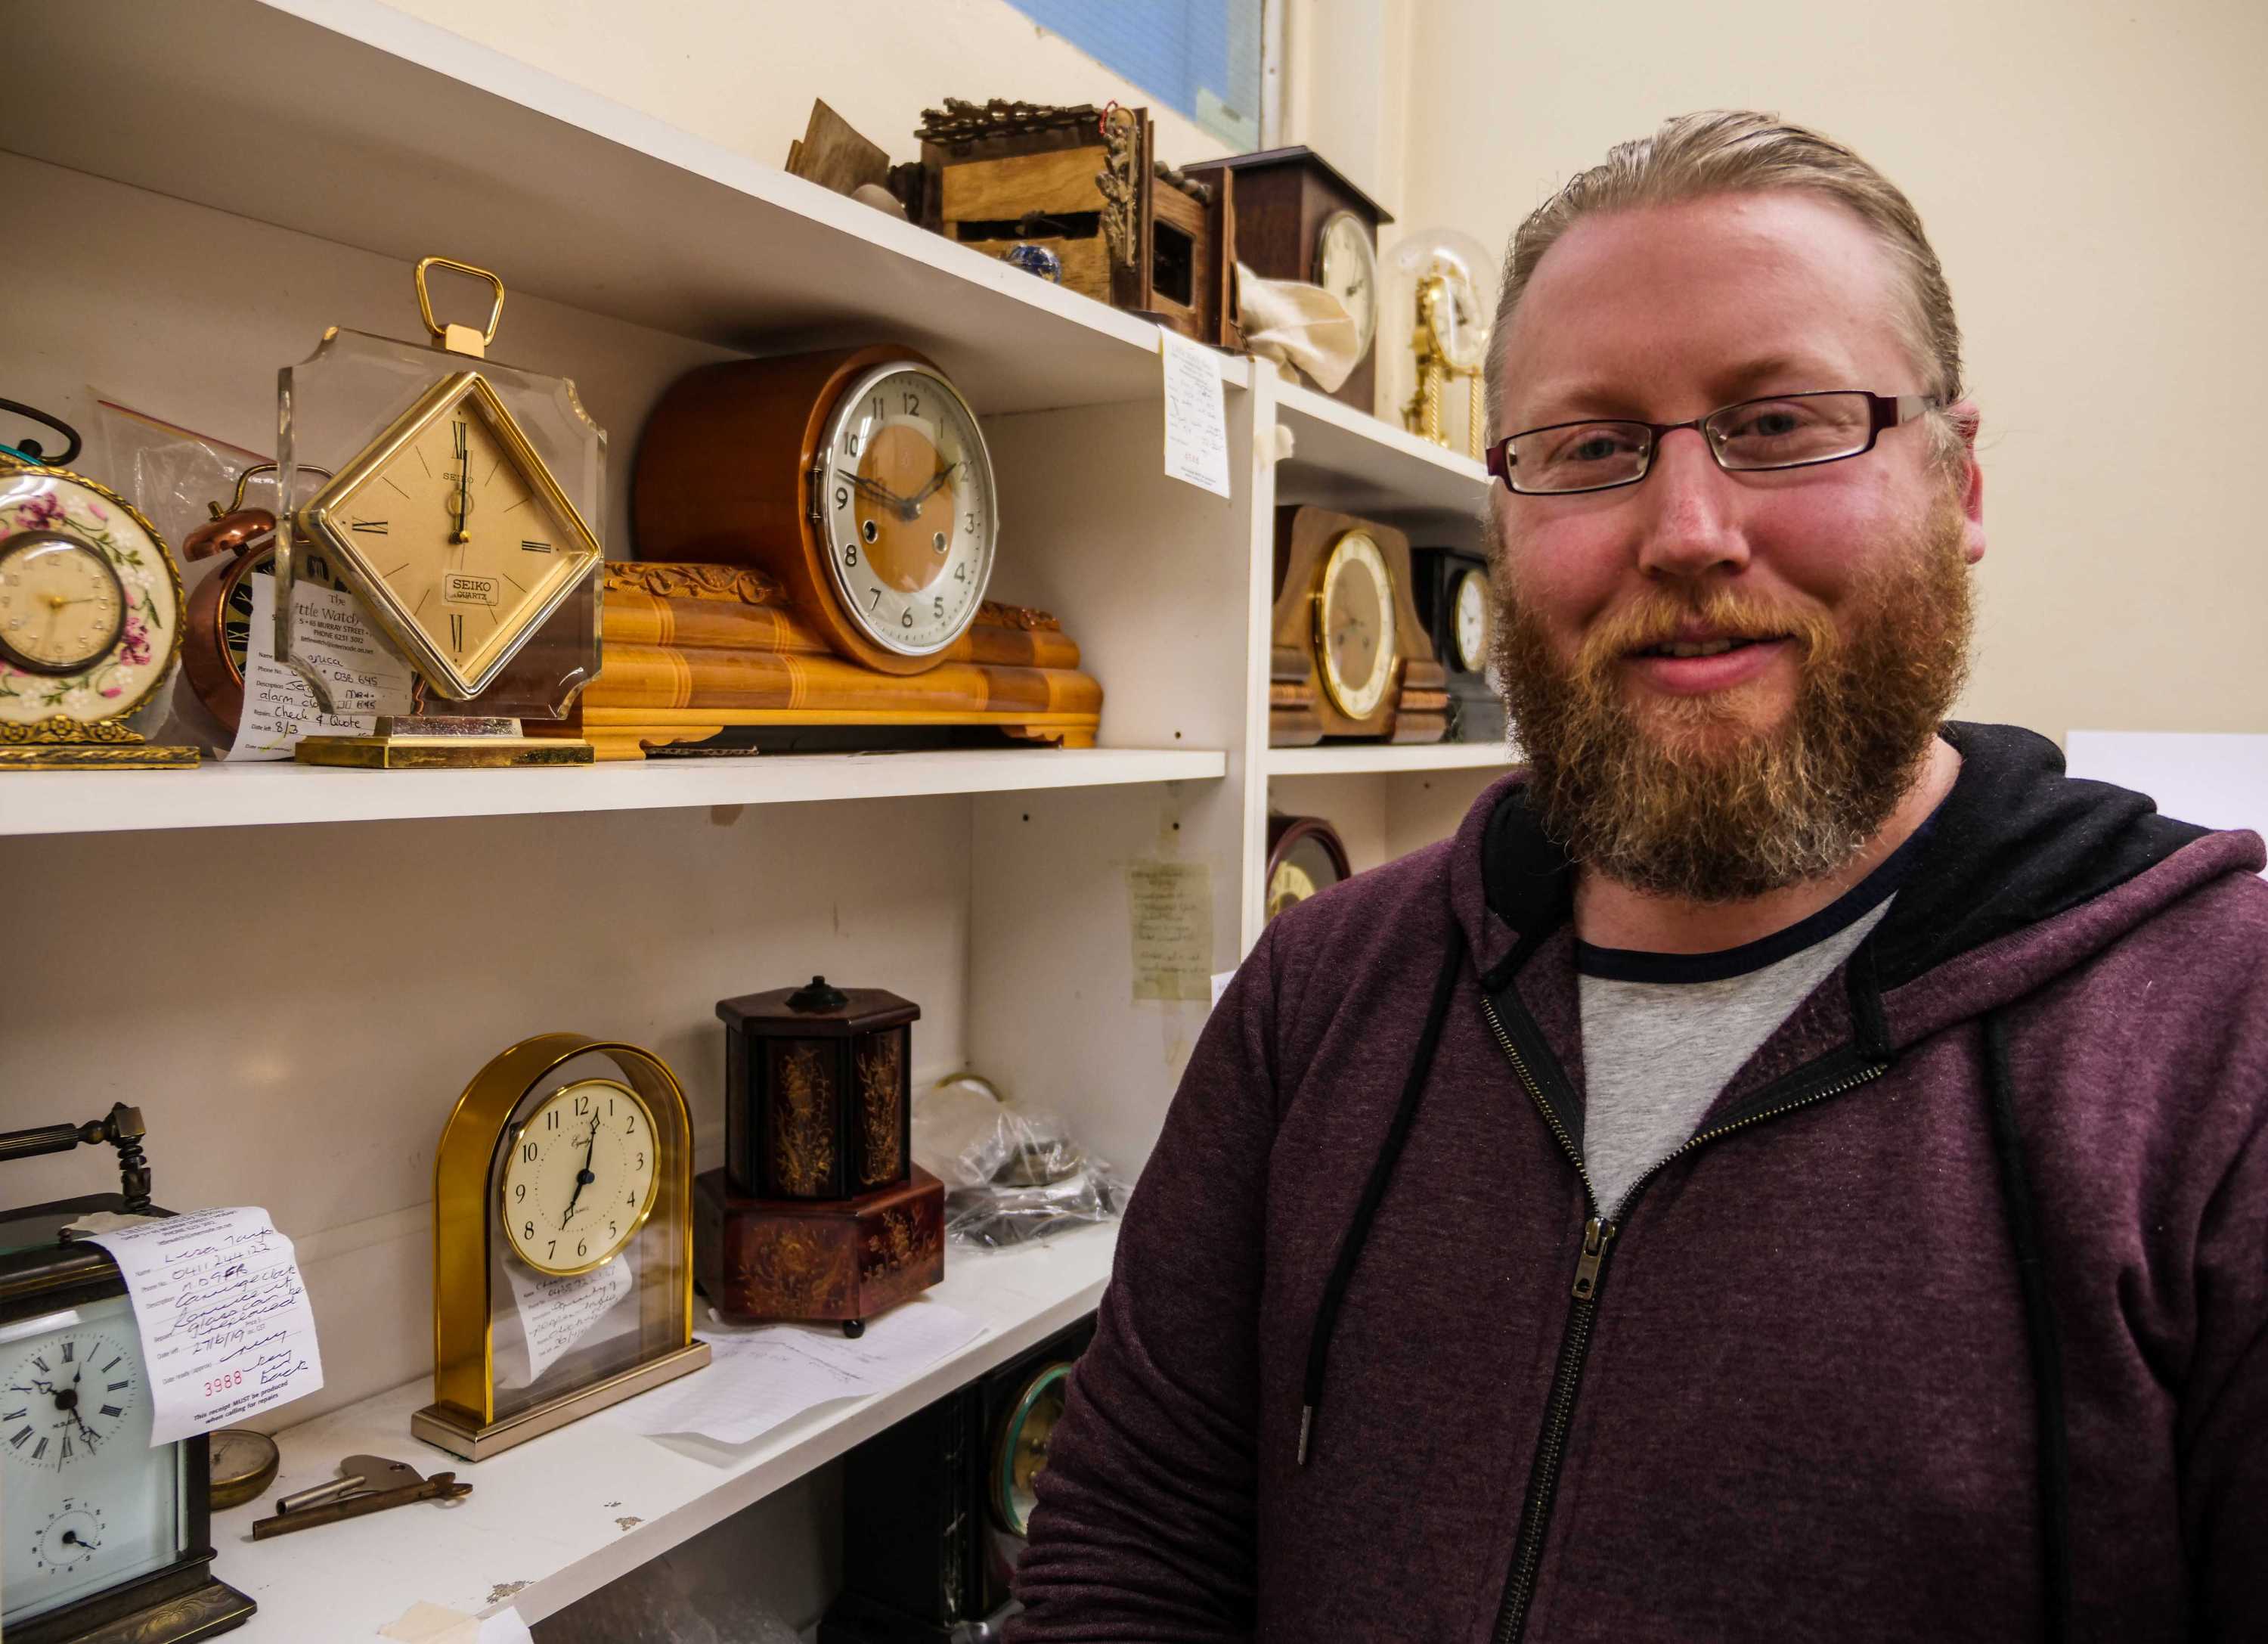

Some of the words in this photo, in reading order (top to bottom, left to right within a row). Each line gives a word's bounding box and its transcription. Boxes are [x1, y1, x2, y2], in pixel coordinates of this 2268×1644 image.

[872, 397, 885, 420] 11
[903, 392, 920, 417] 12
[939, 417, 944, 439] 1
[844, 433, 859, 458] 10
[443, 473, 473, 484] SEIO
[959, 461, 969, 482] 2
[835, 487, 848, 510] 9
[965, 513, 974, 534] 3
[844, 544, 857, 567] 8
[954, 563, 966, 582] 4
[453, 579, 491, 592] SEIKO
[328, 594, 345, 606] The
[869, 588, 881, 611] 7
[933, 597, 944, 619] 5
[901, 606, 913, 628] 6
[314, 629, 333, 639] PHONE
[318, 621, 342, 631] MURRAY
[342, 626, 364, 635] STREET
[256, 681, 284, 690] Description
[260, 689, 293, 703] alarm
[274, 706, 308, 721] Check
[330, 715, 361, 728] Quote
[275, 720, 299, 739] 8/3
[575, 1097, 589, 1115] 12
[609, 1099, 613, 1116] 1
[547, 1111, 559, 1131] 11
[626, 1116, 635, 1134] 2
[522, 1143, 538, 1163] 10
[636, 1152, 643, 1171] 3
[516, 1184, 525, 1204] 9
[627, 1190, 635, 1207] 4
[524, 1221, 534, 1240] 8
[609, 1221, 616, 1239] 5
[548, 1240, 556, 1260] 7
[578, 1238, 587, 1256] 6
[204, 1370, 243, 1397] 3988
[194, 1413, 207, 1421] This
[209, 1403, 231, 1416] receipt
[233, 1396, 250, 1407] MUST
[261, 1380, 289, 1397] produced
[206, 1414, 224, 1424] when
[226, 1406, 246, 1418] calling
[247, 1401, 256, 1410] for
[258, 1393, 279, 1405] repairs
